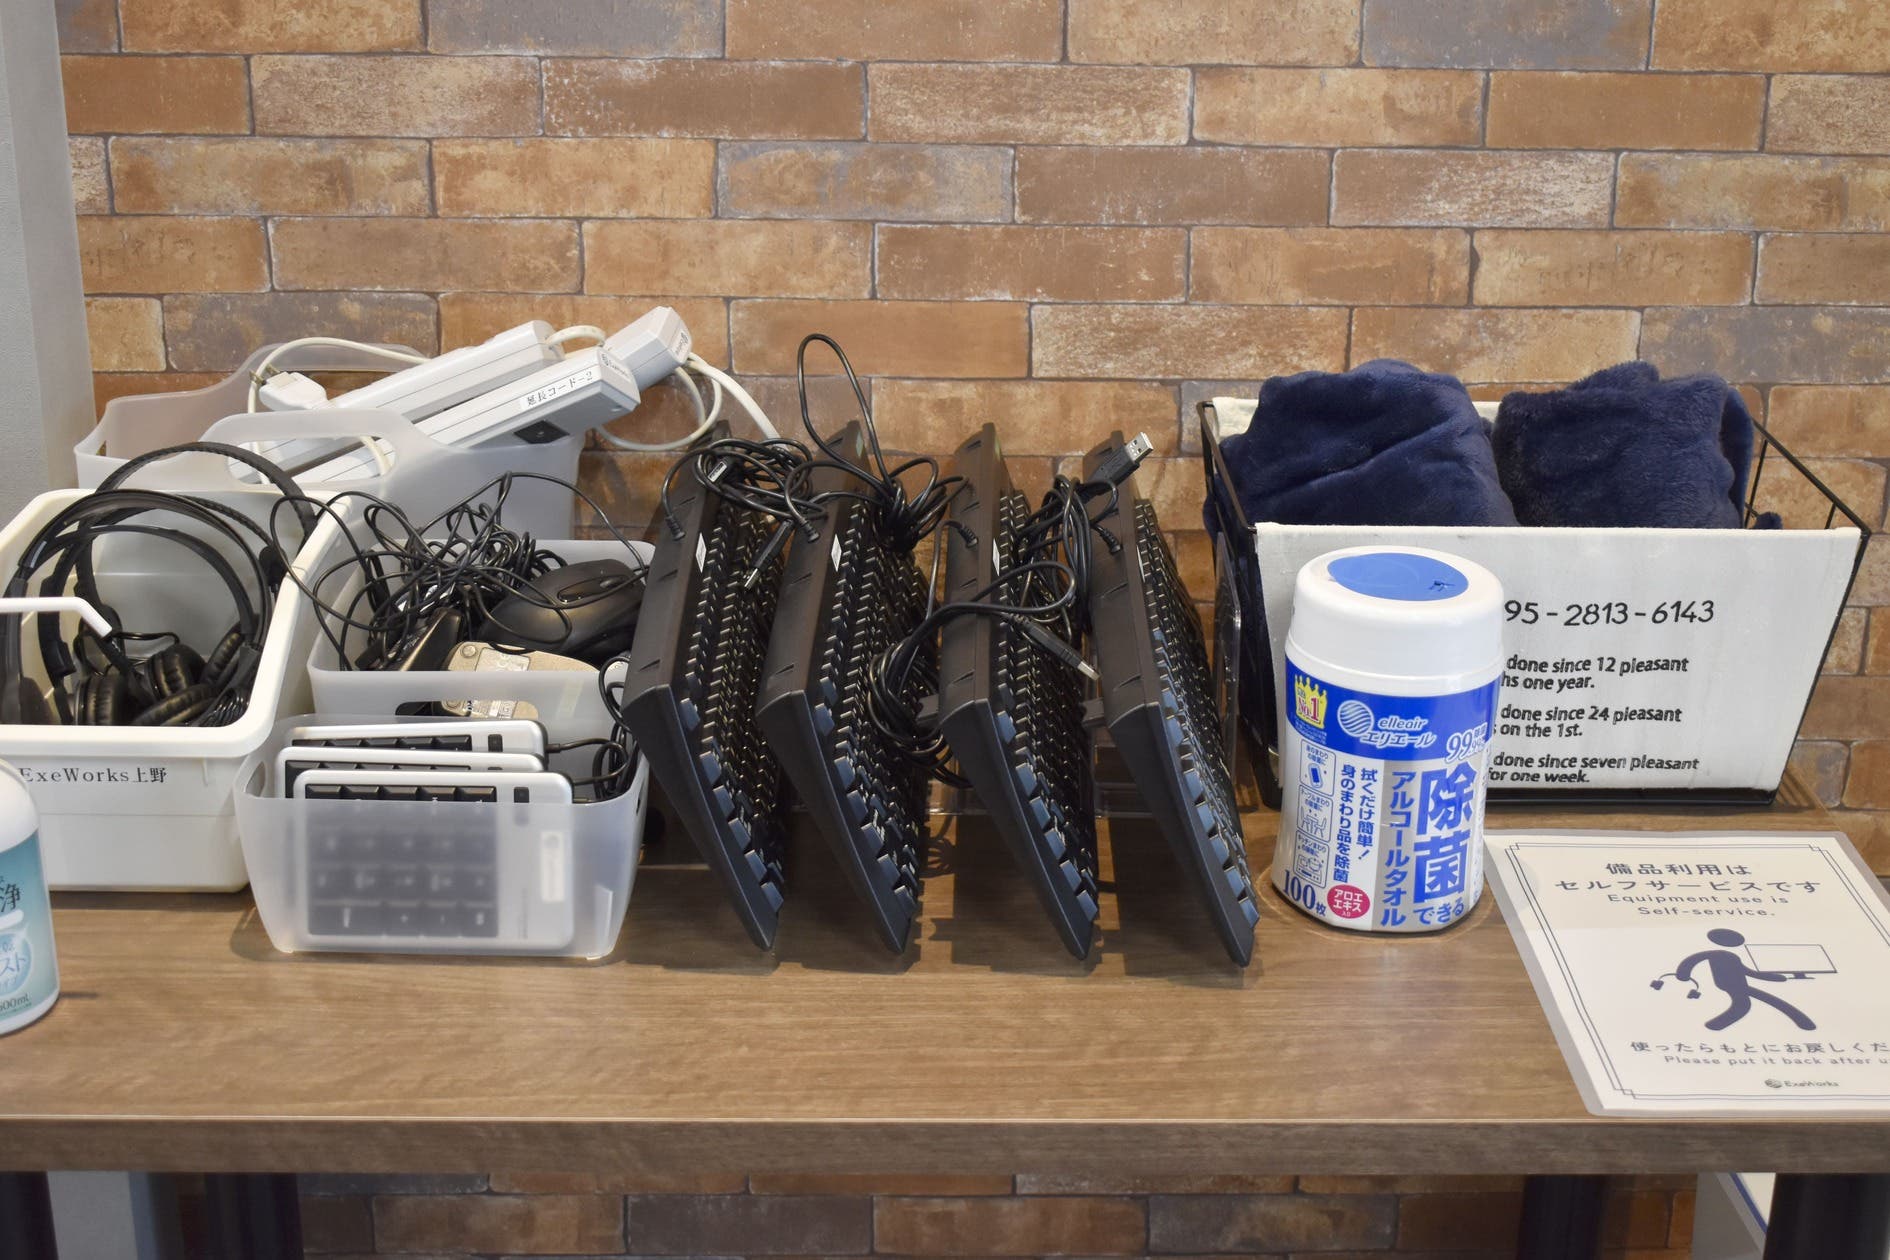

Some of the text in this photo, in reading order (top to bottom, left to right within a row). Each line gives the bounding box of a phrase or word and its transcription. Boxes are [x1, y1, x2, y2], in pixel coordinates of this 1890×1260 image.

[1507, 655, 1689, 676] done since 12 pleasant
[1523, 677, 1554, 689] one
[1557, 677, 1595, 693] year.
[1501, 704, 1682, 725] done since 24 pleasant
[1379, 716, 1427, 730] elleair
[1500, 723, 1520, 736] on
[1525, 722, 1551, 737] the
[1557, 723, 1583, 737] 1st.
[1363, 732, 1437, 746] エリエール
[1493, 752, 1699, 771] done since seven pleasant
[1510, 771, 1541, 782] one
[1544, 769, 1590, 783] week.
[1333, 764, 1356, 883] 身のまわり品を除菌
[1413, 761, 1477, 903] 除菌
[1380, 771, 1417, 927] アルコールタオル
[1606, 862, 1752, 875] 備品利用は
[1555, 880, 1820, 892] セルフサービスです
[1334, 888, 1363, 902] アロエ
[1607, 894, 1789, 904] Equipment use is
[1333, 899, 1361, 912] エキス
[1413, 897, 1465, 925] できる
[1637, 906, 1776, 916] Self-service.
[1664, 1055, 1721, 1064] Please
[1728, 1057, 1757, 1066] put
[1763, 1056, 1775, 1064] it
[1782, 1056, 1822, 1064] back
[1830, 1056, 1870, 1064] after
